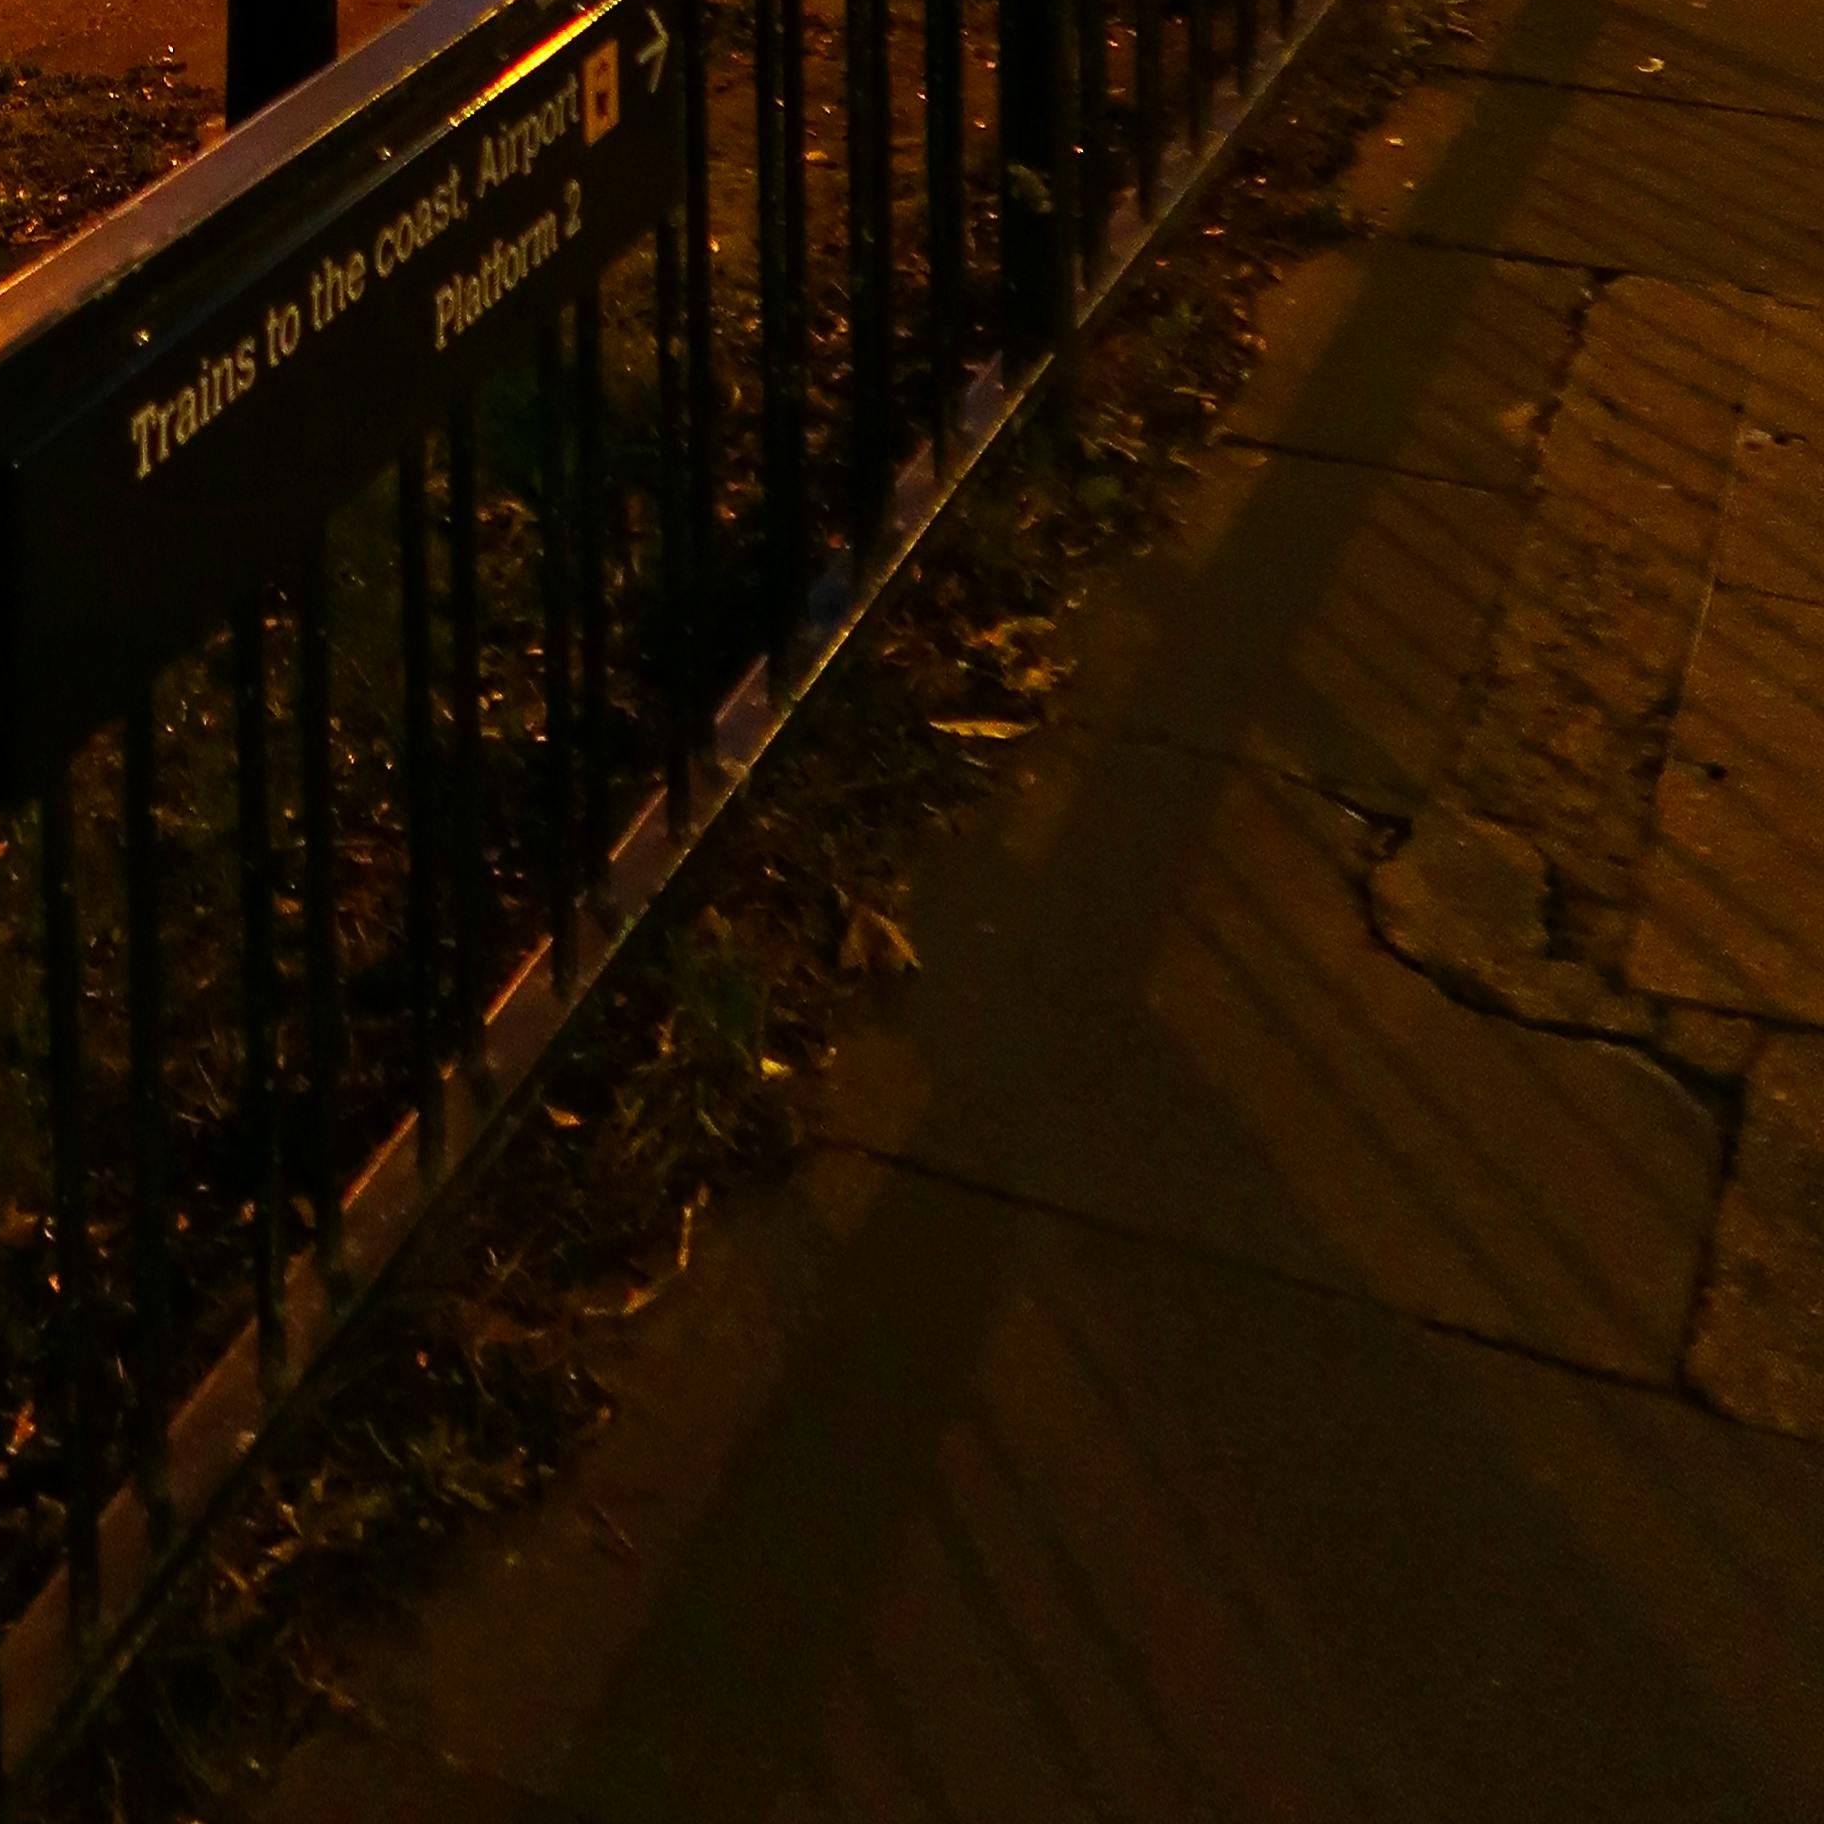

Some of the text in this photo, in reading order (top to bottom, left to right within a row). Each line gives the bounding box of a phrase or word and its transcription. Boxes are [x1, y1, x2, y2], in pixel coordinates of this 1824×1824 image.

[132, 339, 255, 478] Trains
[266, 304, 300, 366] to
[311, 252, 365, 330] the
[478, 74, 580, 197] Airport
[435, 180, 581, 350] Platform 2
